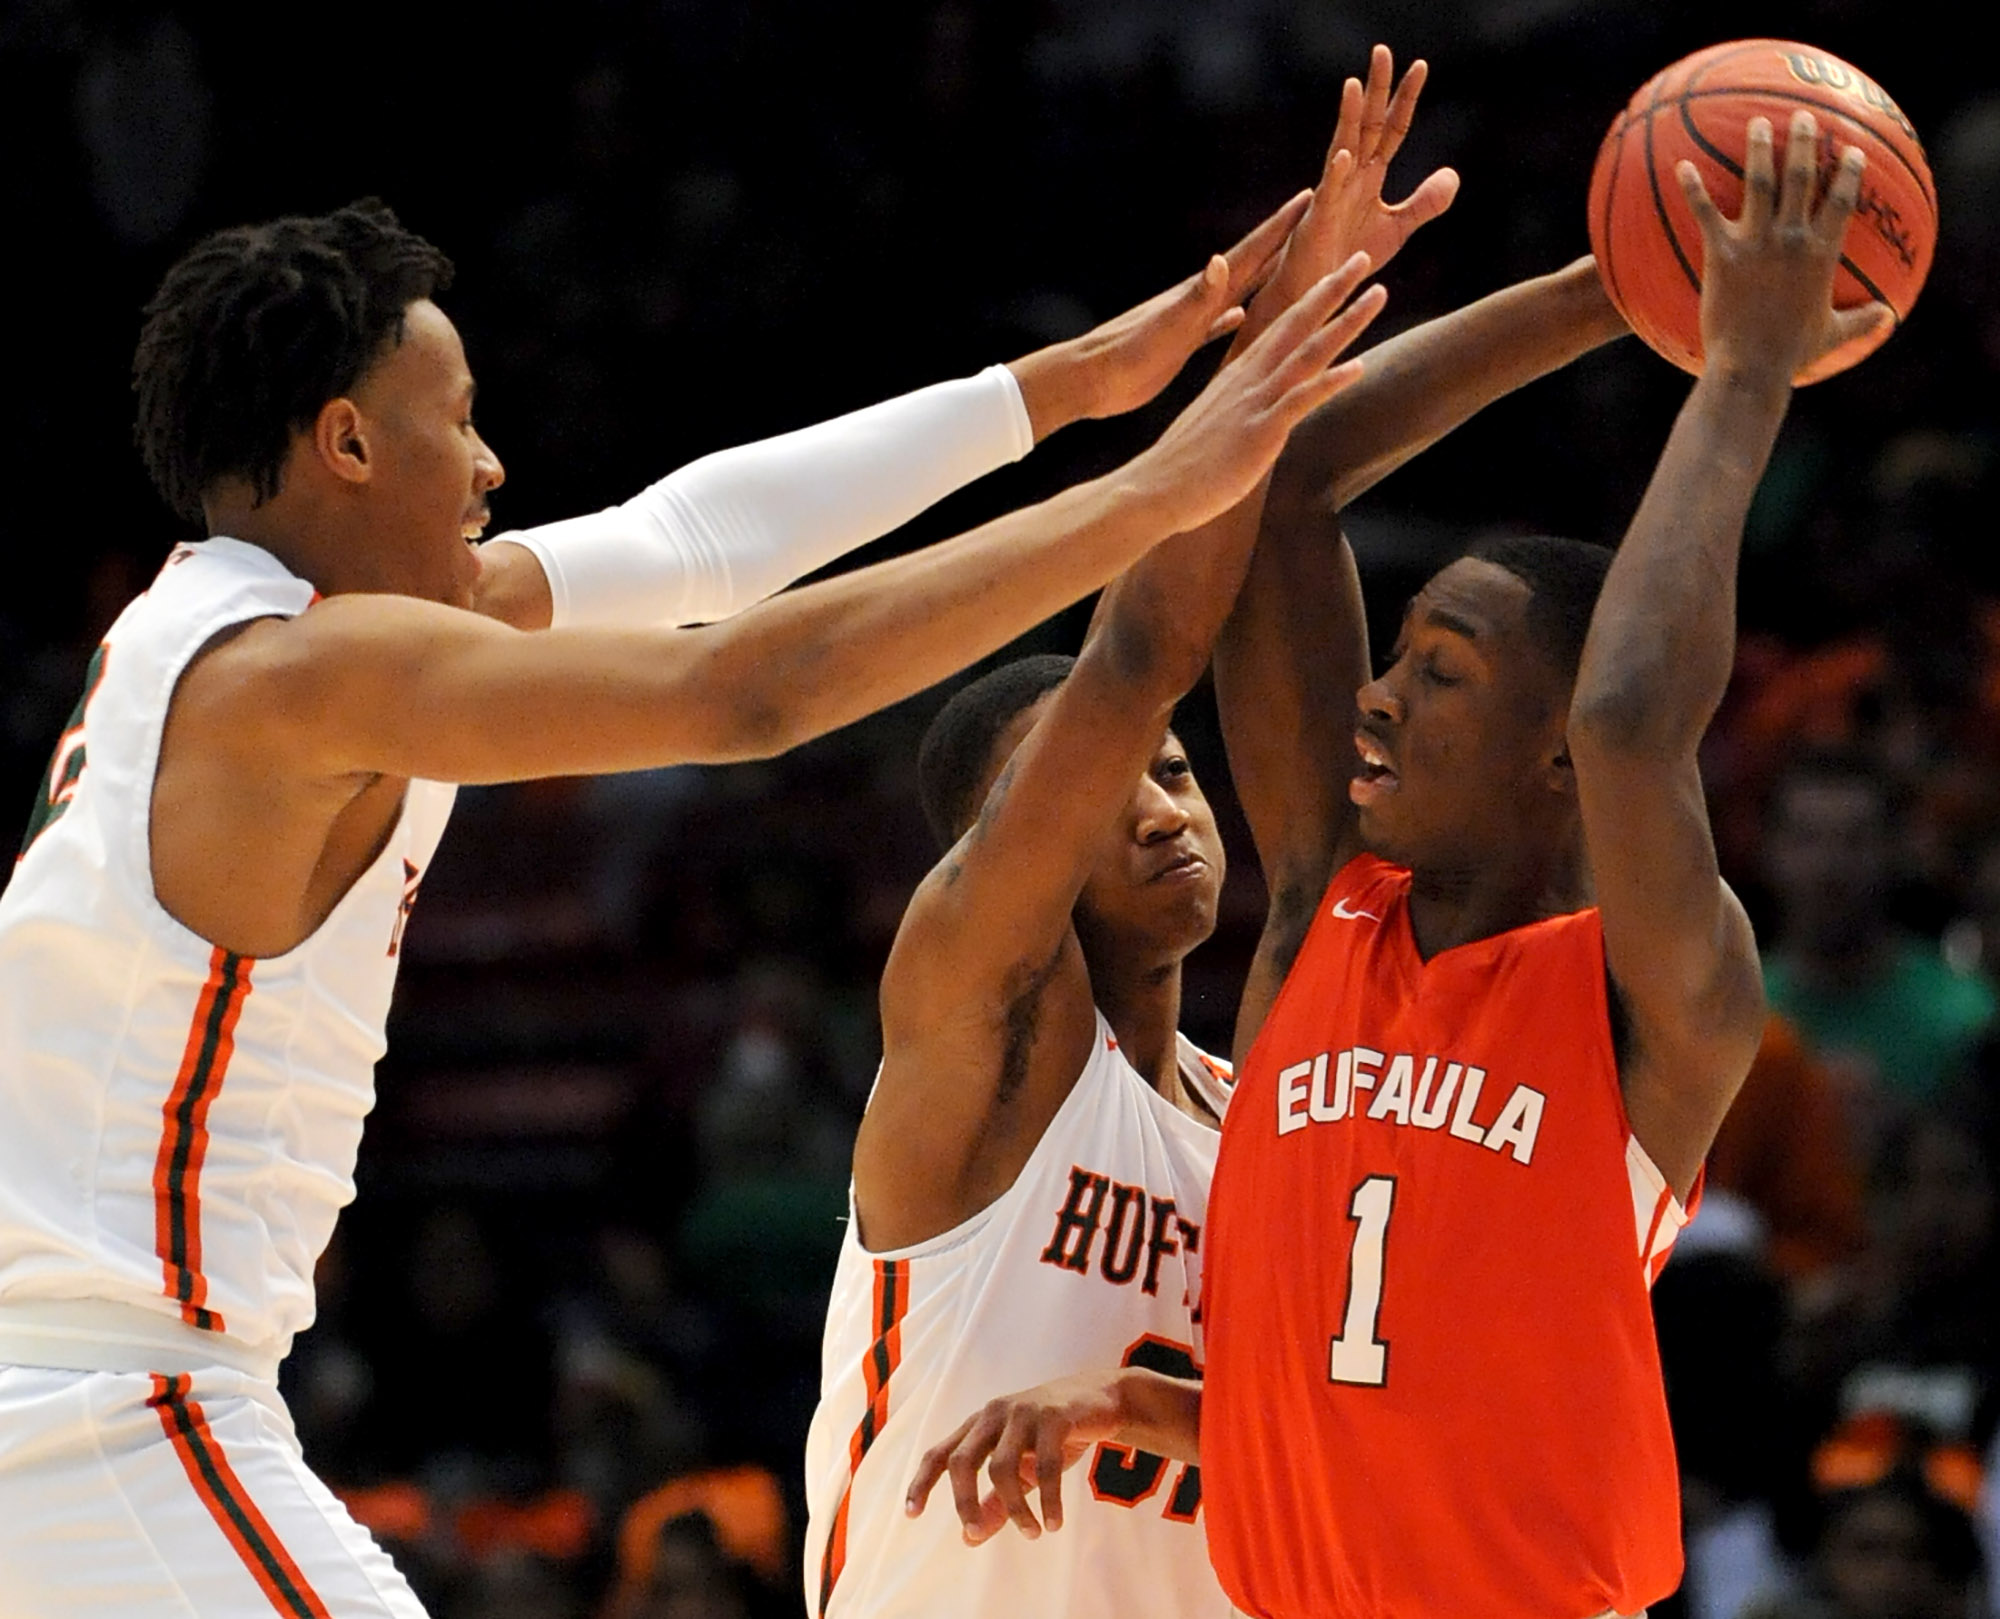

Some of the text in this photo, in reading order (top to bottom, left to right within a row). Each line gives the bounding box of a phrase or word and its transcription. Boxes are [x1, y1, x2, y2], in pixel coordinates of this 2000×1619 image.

[1277, 1046, 1546, 1166] EUFAULA
[1039, 1163, 1203, 1326] HUF
[1328, 1173, 1398, 1387] 1
